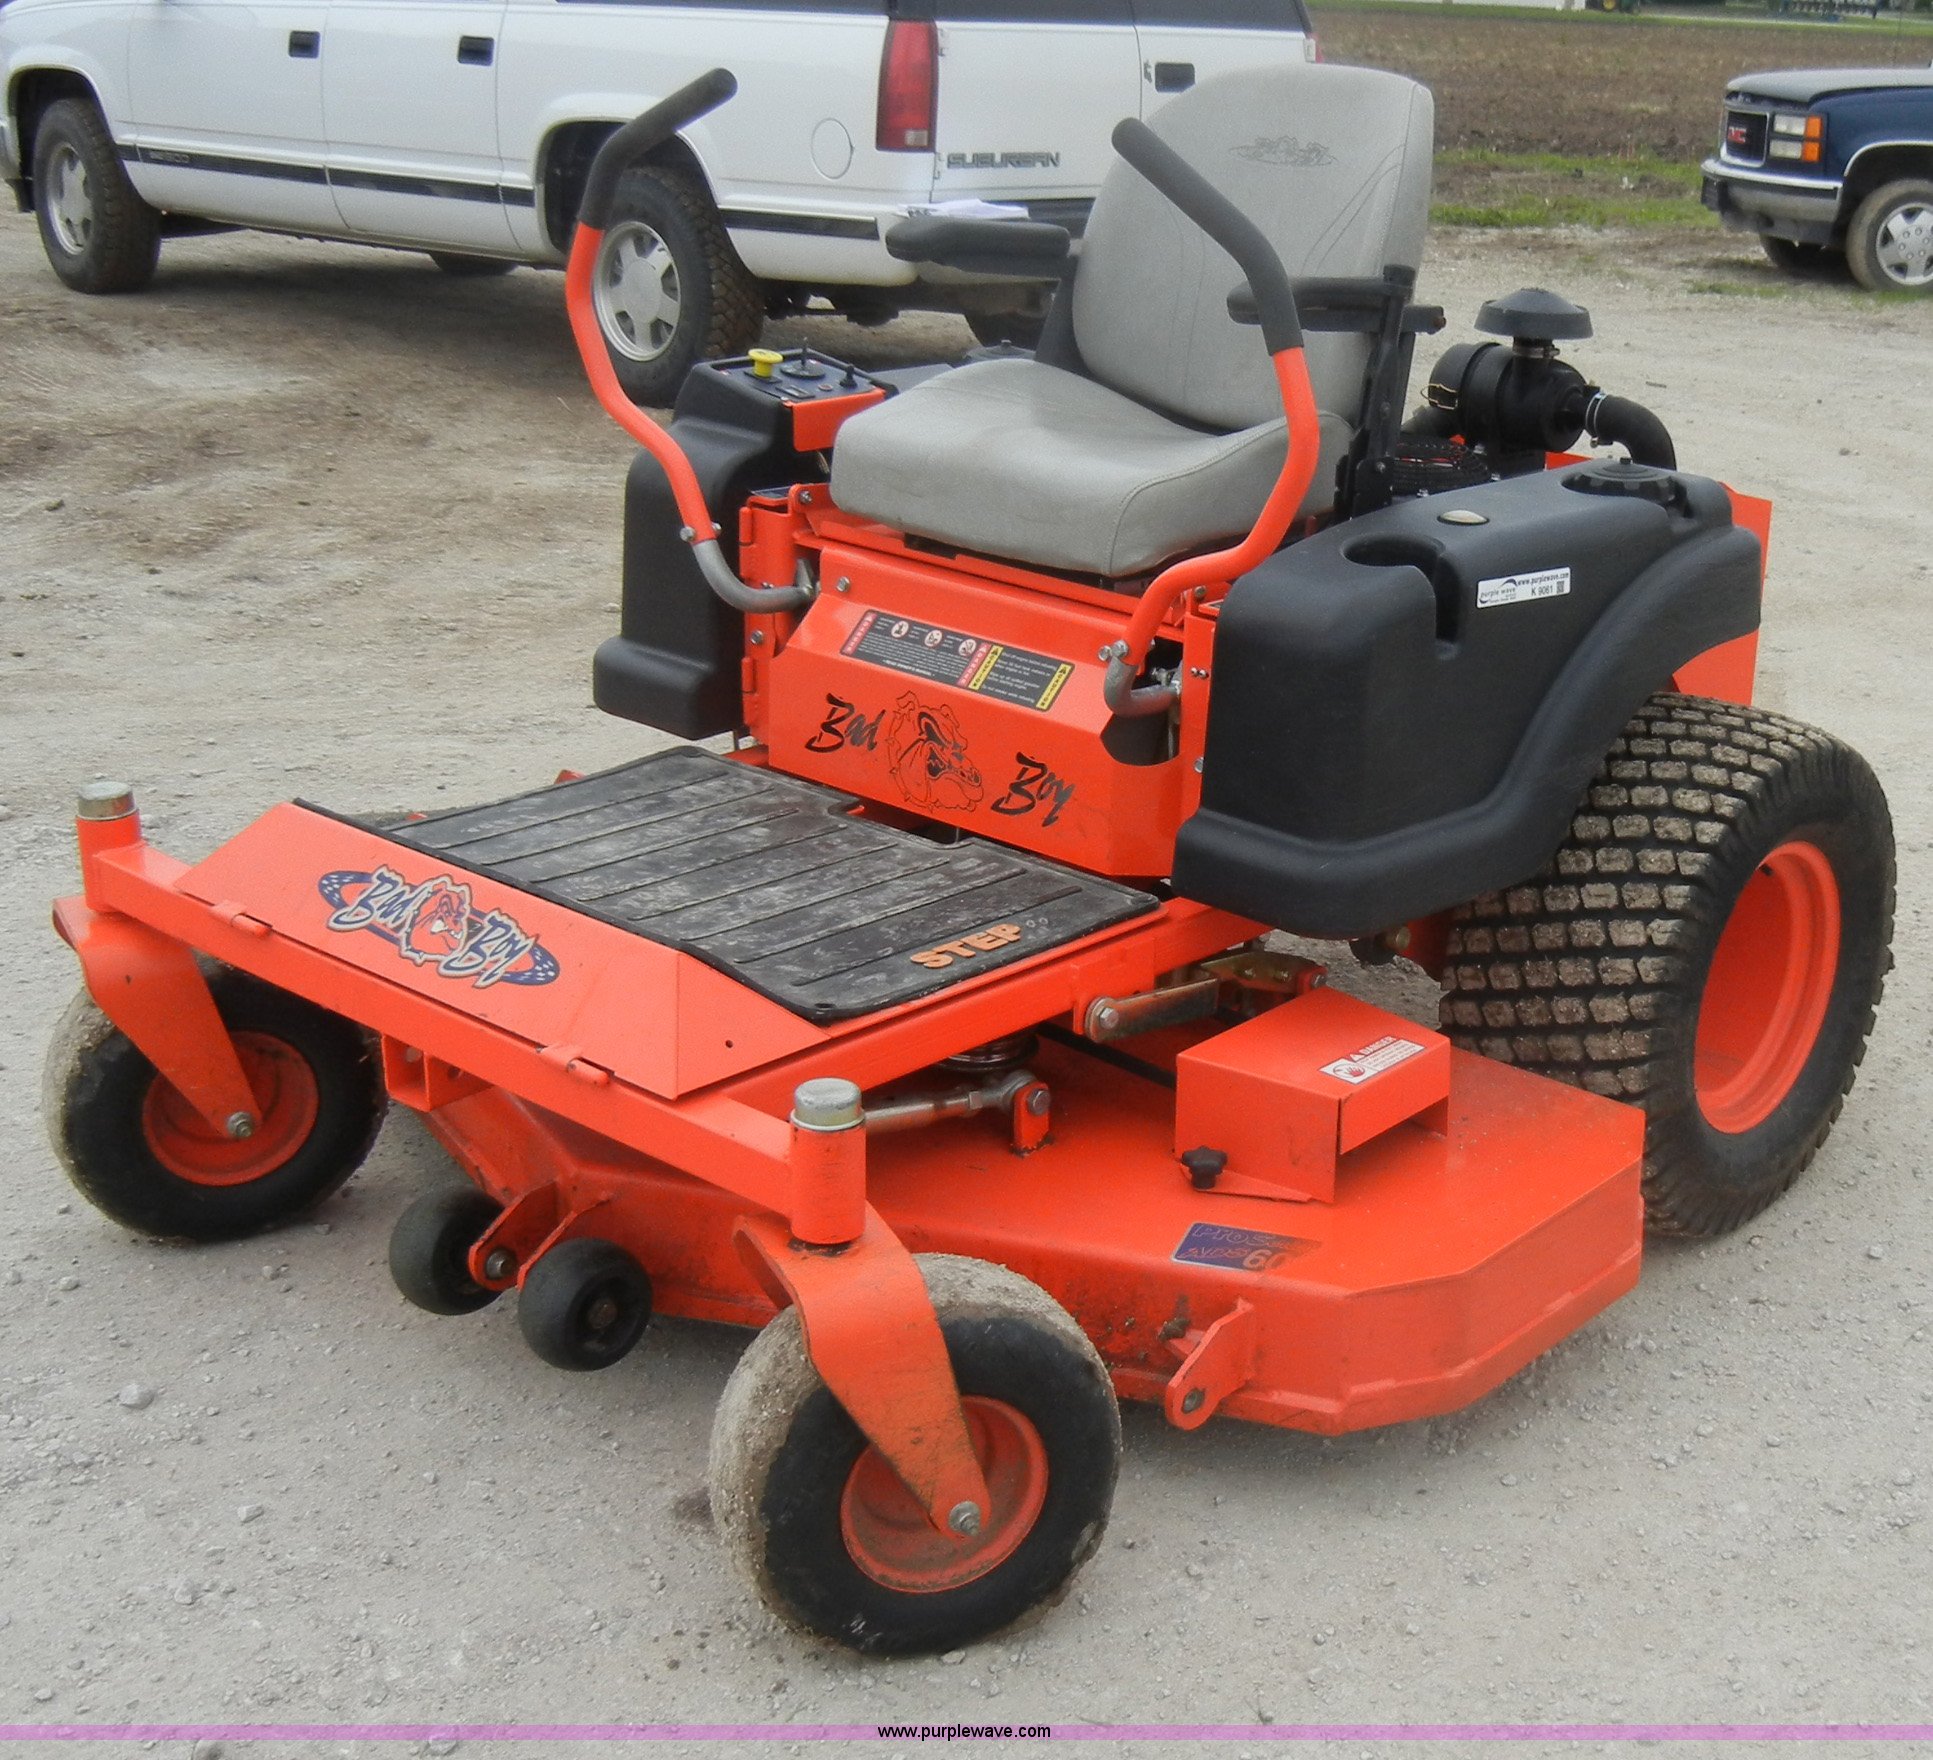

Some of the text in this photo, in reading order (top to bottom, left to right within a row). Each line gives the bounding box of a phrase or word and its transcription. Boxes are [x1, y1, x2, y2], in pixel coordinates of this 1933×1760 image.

[947, 152, 1060, 168] SUBURBAN
[1518, 573, 1569, 585] www.purplewave.com
[804, 692, 1075, 827] Bad Boy
[330, 867, 538, 986] Bad Boy
[910, 924, 1021, 968] STEP
